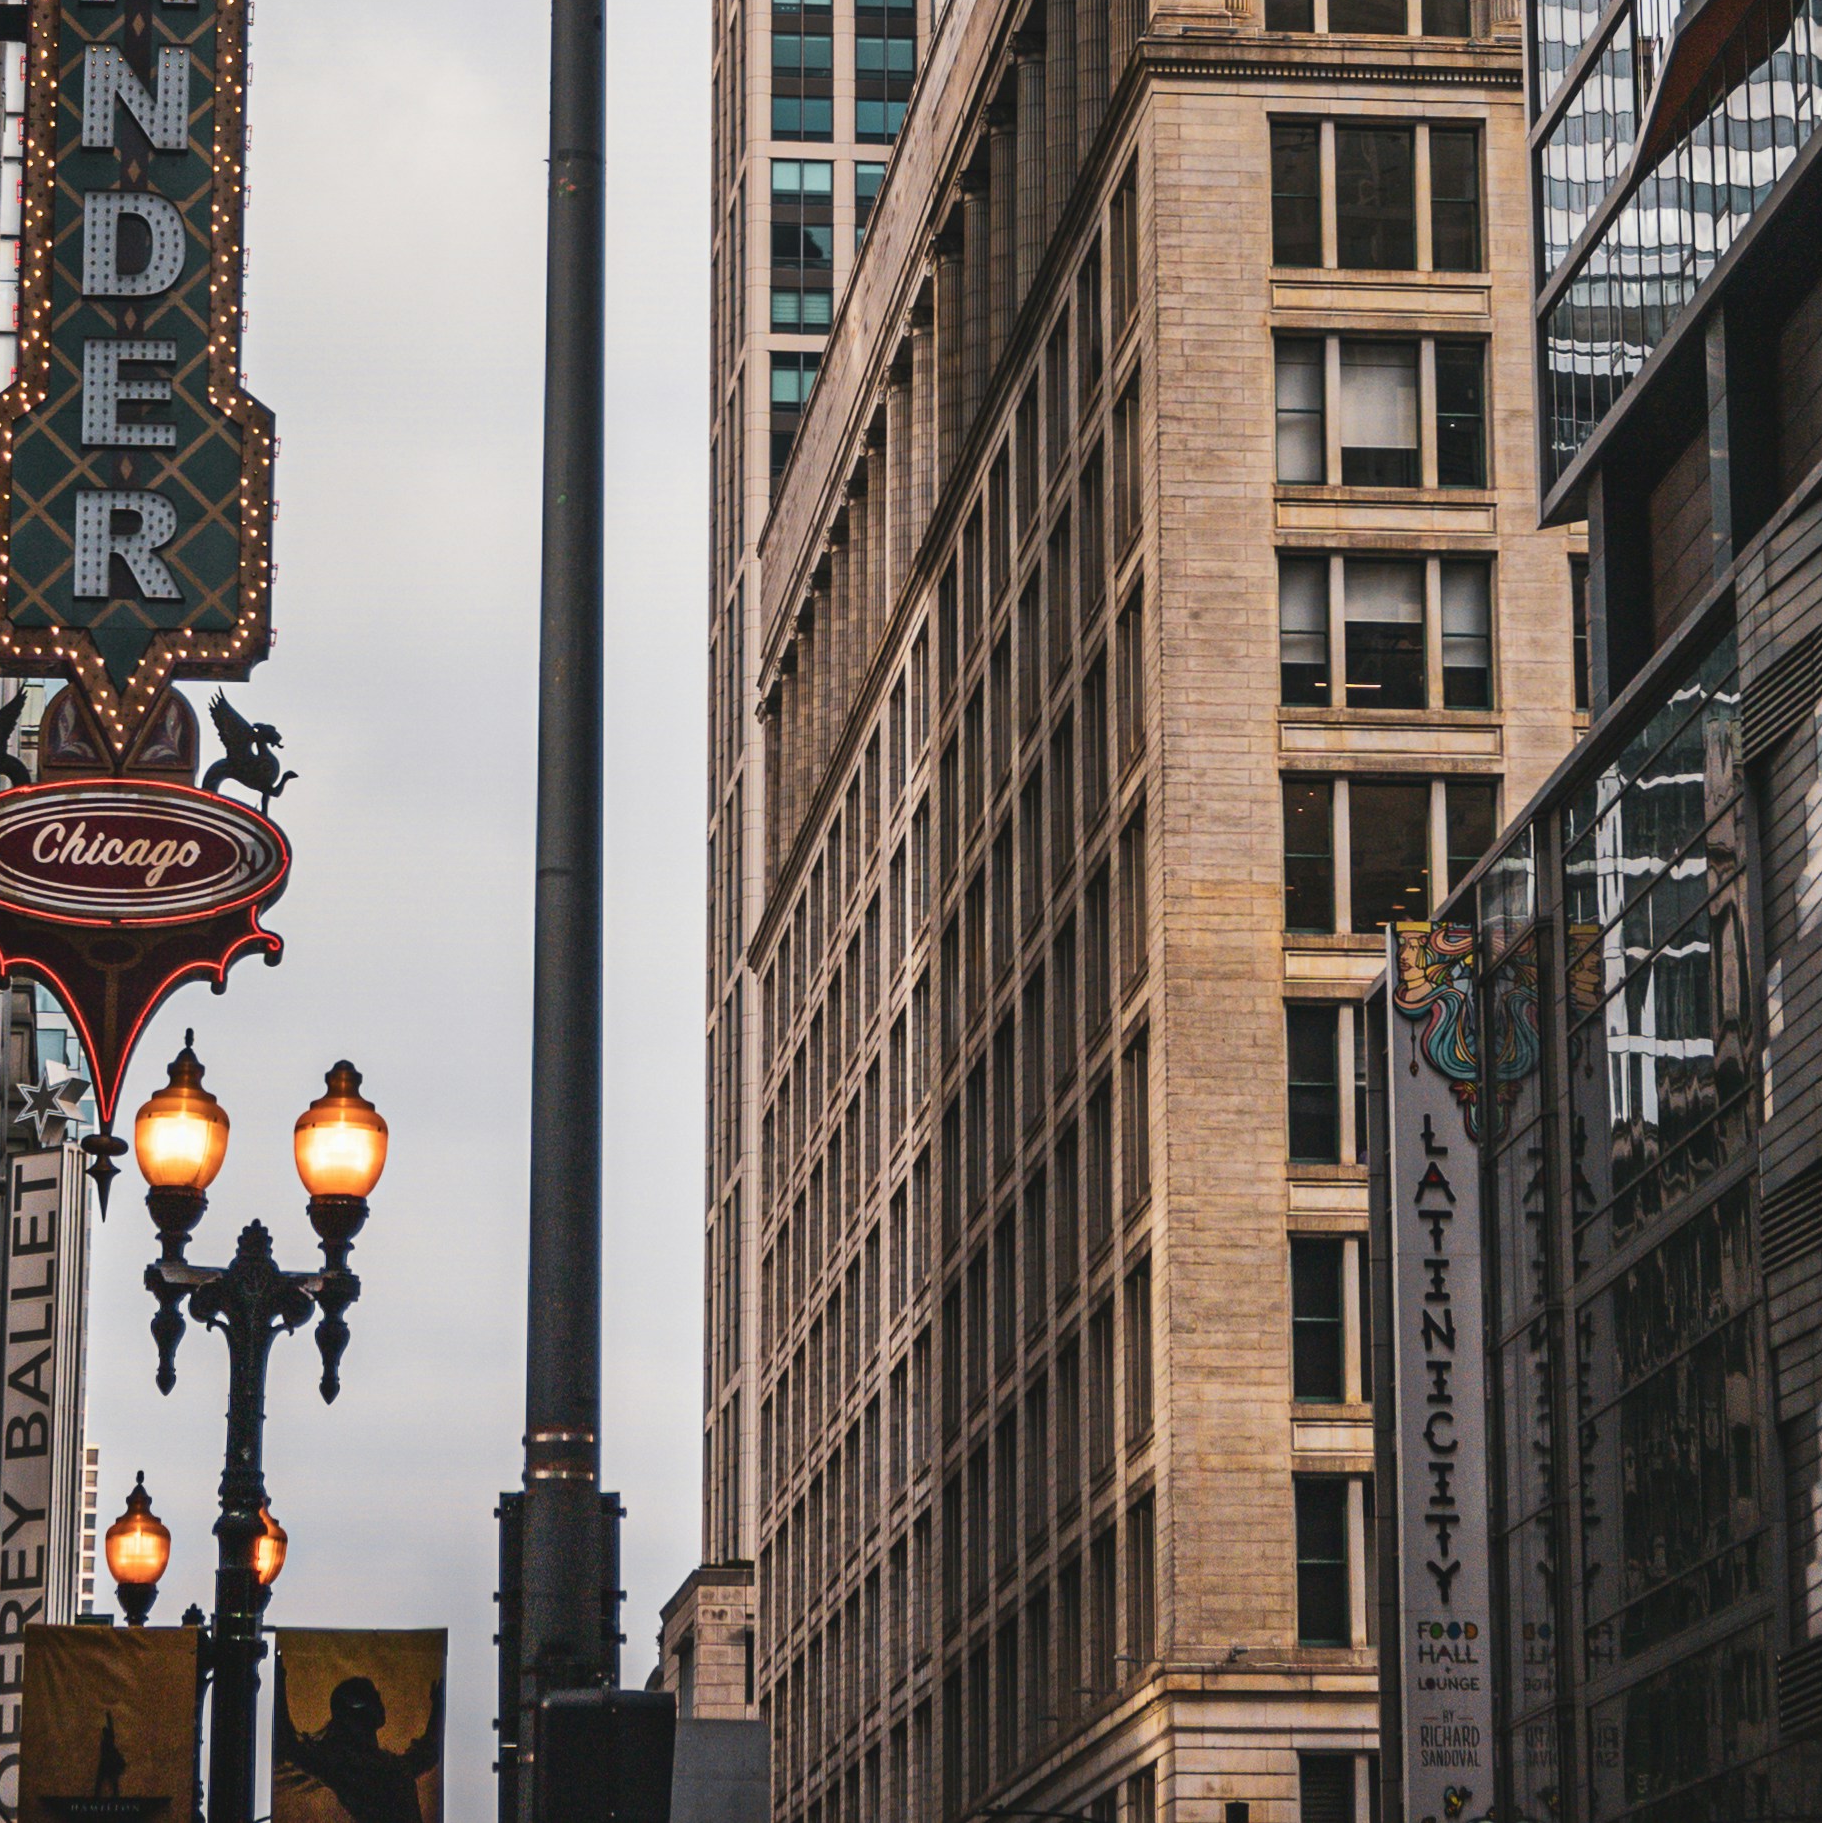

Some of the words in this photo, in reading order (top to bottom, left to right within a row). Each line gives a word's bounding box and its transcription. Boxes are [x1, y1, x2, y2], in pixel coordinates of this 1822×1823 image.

[32, 821, 201, 888] Chicago
[5, 1164, 58, 1460] BALLET
[1414, 1113, 1461, 1604] LATINICITY
[1416, 1621, 1479, 1641] FOOD
[1417, 1644, 1479, 1665] HALL
[1417, 1676, 1480, 1691] LOUNGE
[1420, 1725, 1480, 1748] RICHARD
[1421, 1749, 1481, 1767] SANDOVAL
